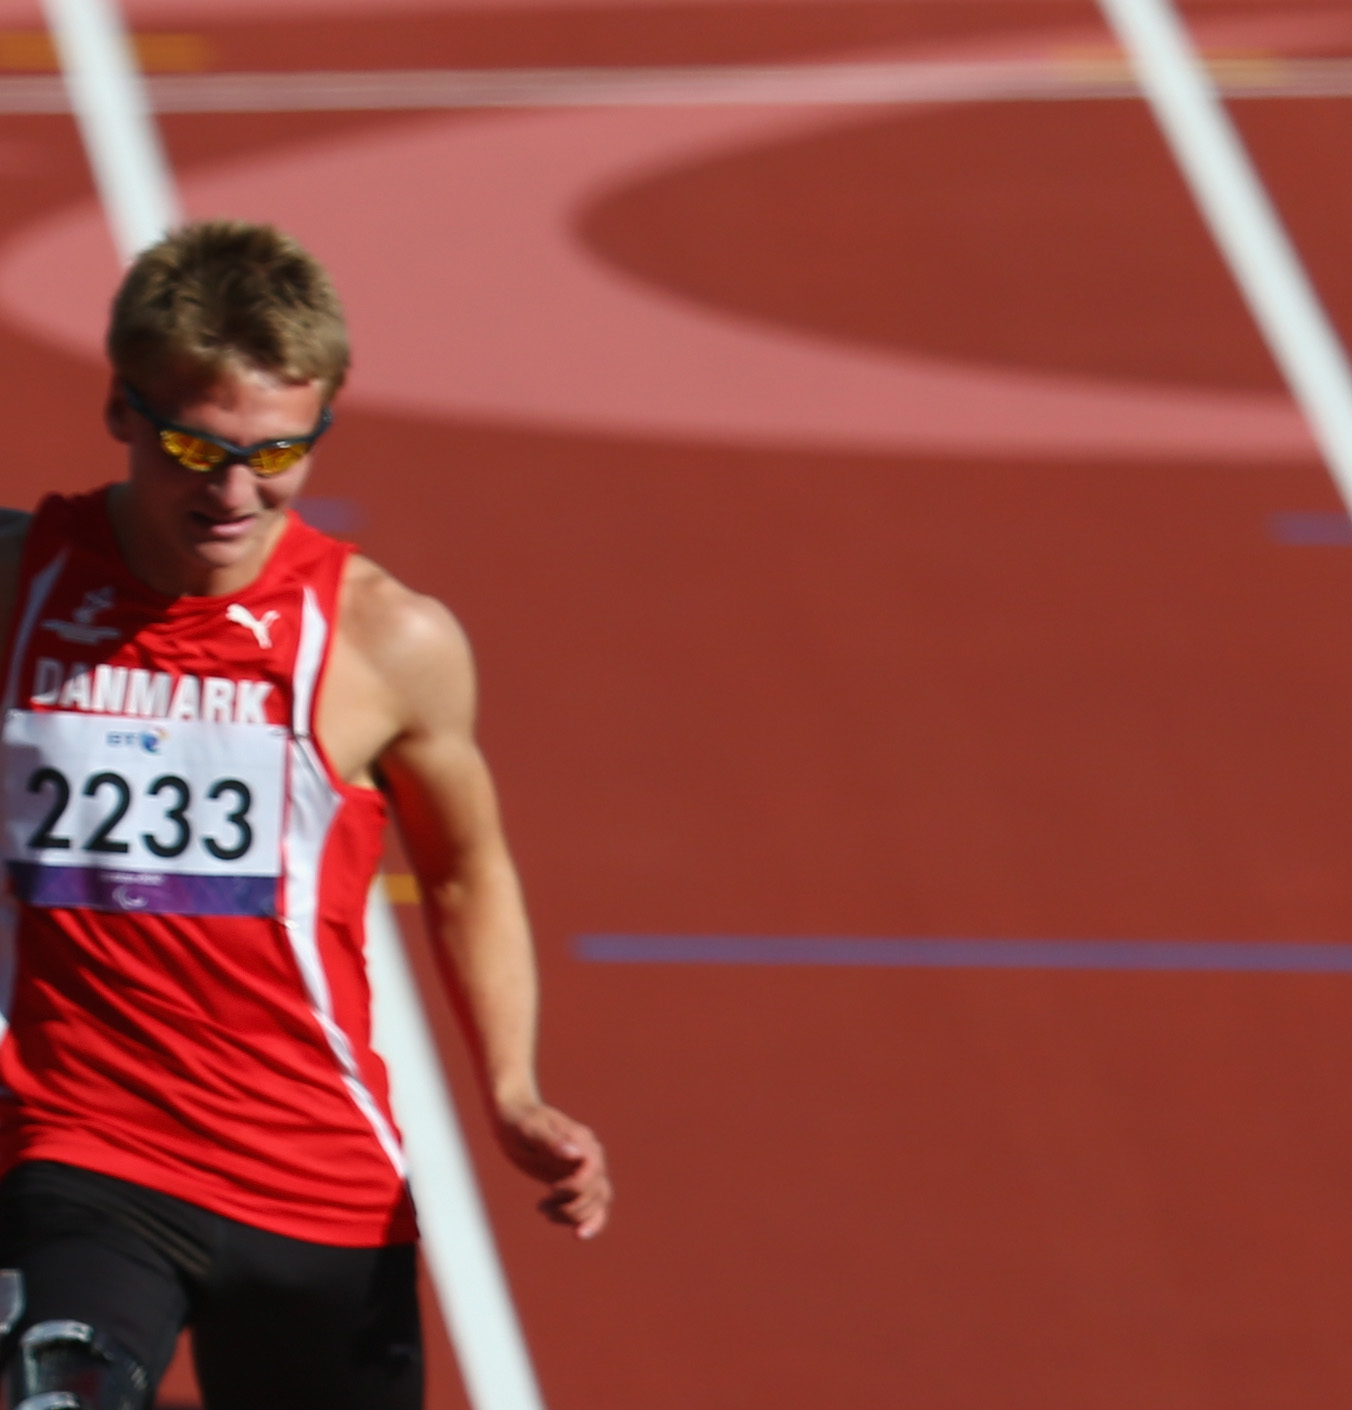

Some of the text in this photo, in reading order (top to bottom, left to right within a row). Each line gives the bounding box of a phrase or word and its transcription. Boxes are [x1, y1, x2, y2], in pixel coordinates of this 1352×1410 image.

[32, 661, 273, 725] DANMARK
[107, 731, 134, 748] BT
[28, 768, 253, 860] 2233
